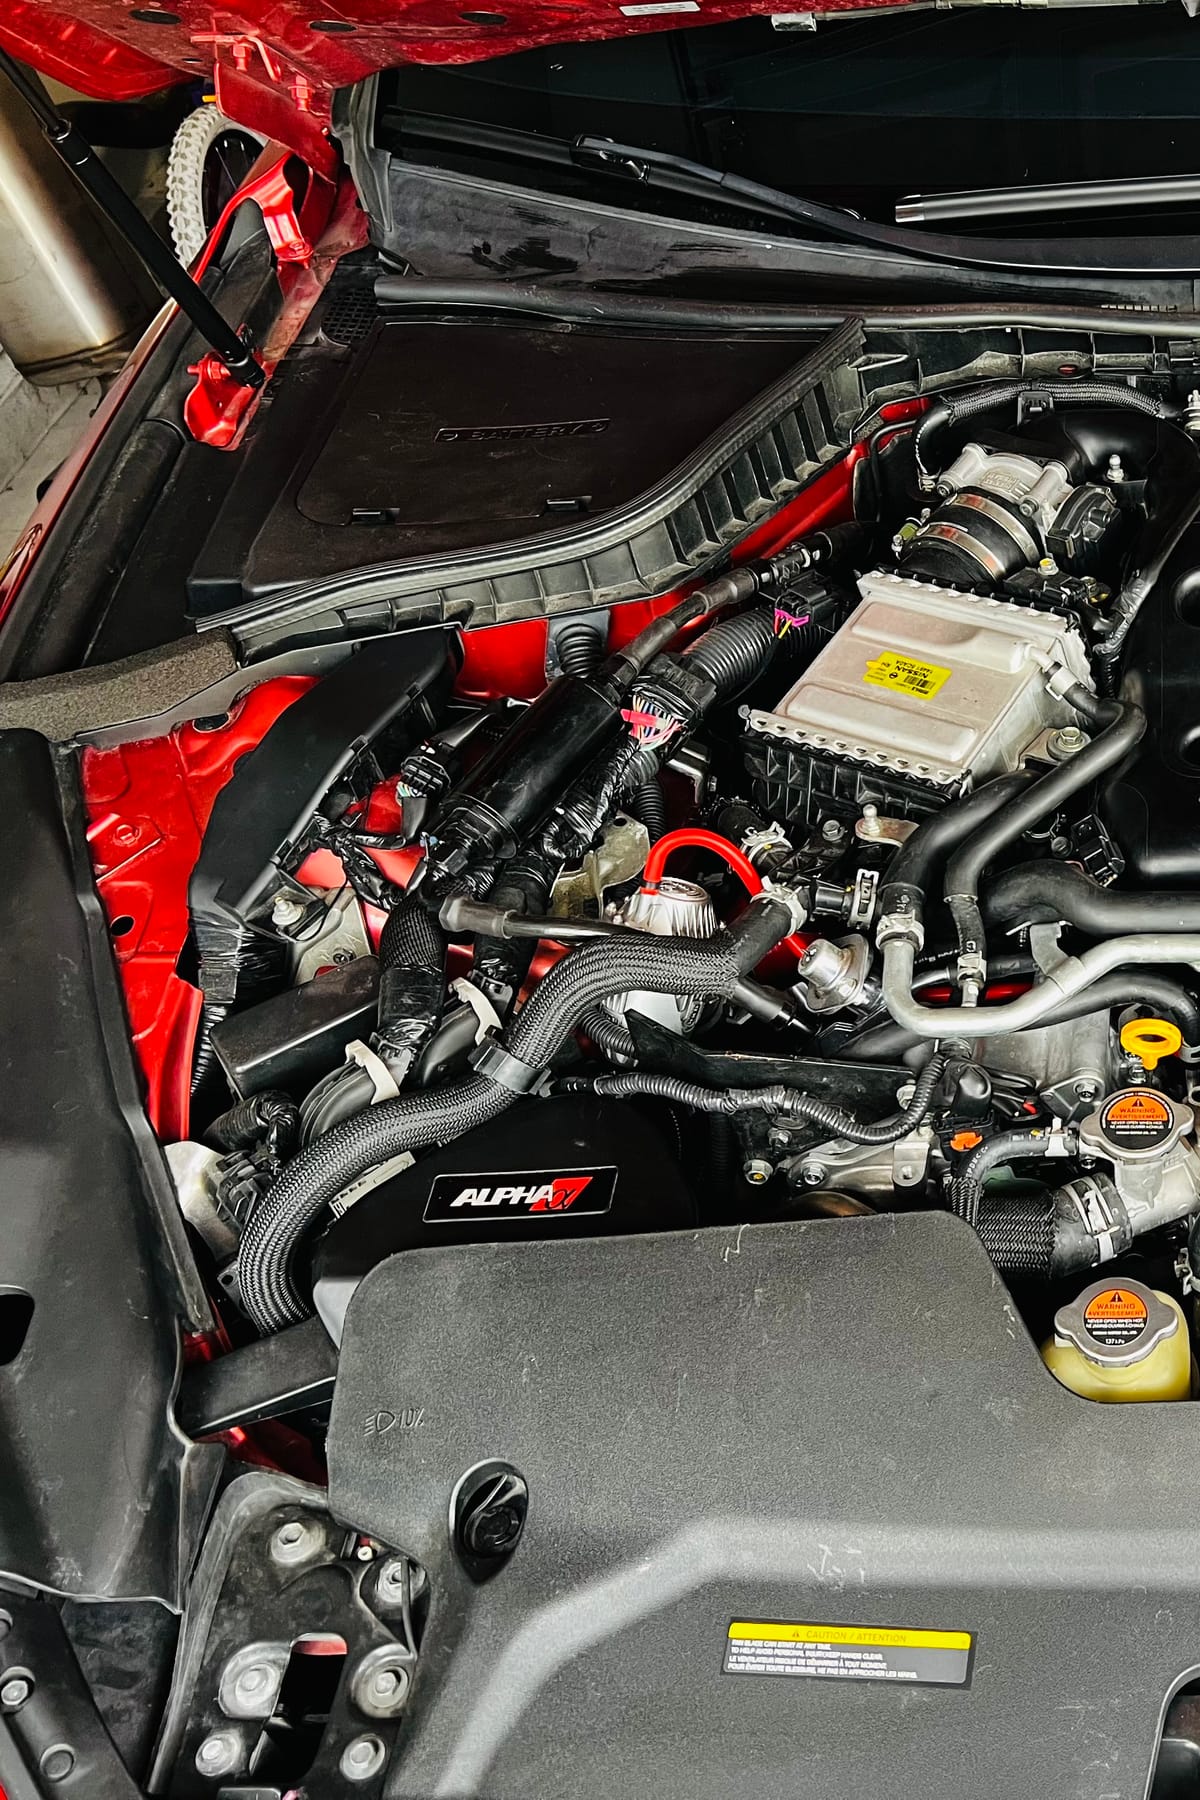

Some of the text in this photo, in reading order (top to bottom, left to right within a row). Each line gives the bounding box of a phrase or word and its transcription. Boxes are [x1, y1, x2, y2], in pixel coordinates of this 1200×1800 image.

[470, 423, 584, 441] BATTERY
[895, 665, 929, 679] NISSAN
[450, 1184, 555, 1207] ALPHA
[806, 1630, 848, 1641] CAUTION
[856, 1632, 907, 1643] ATTENTION
[755, 1647, 773, 1655] AVOID
[728, 1662, 745, 1670] POUR
